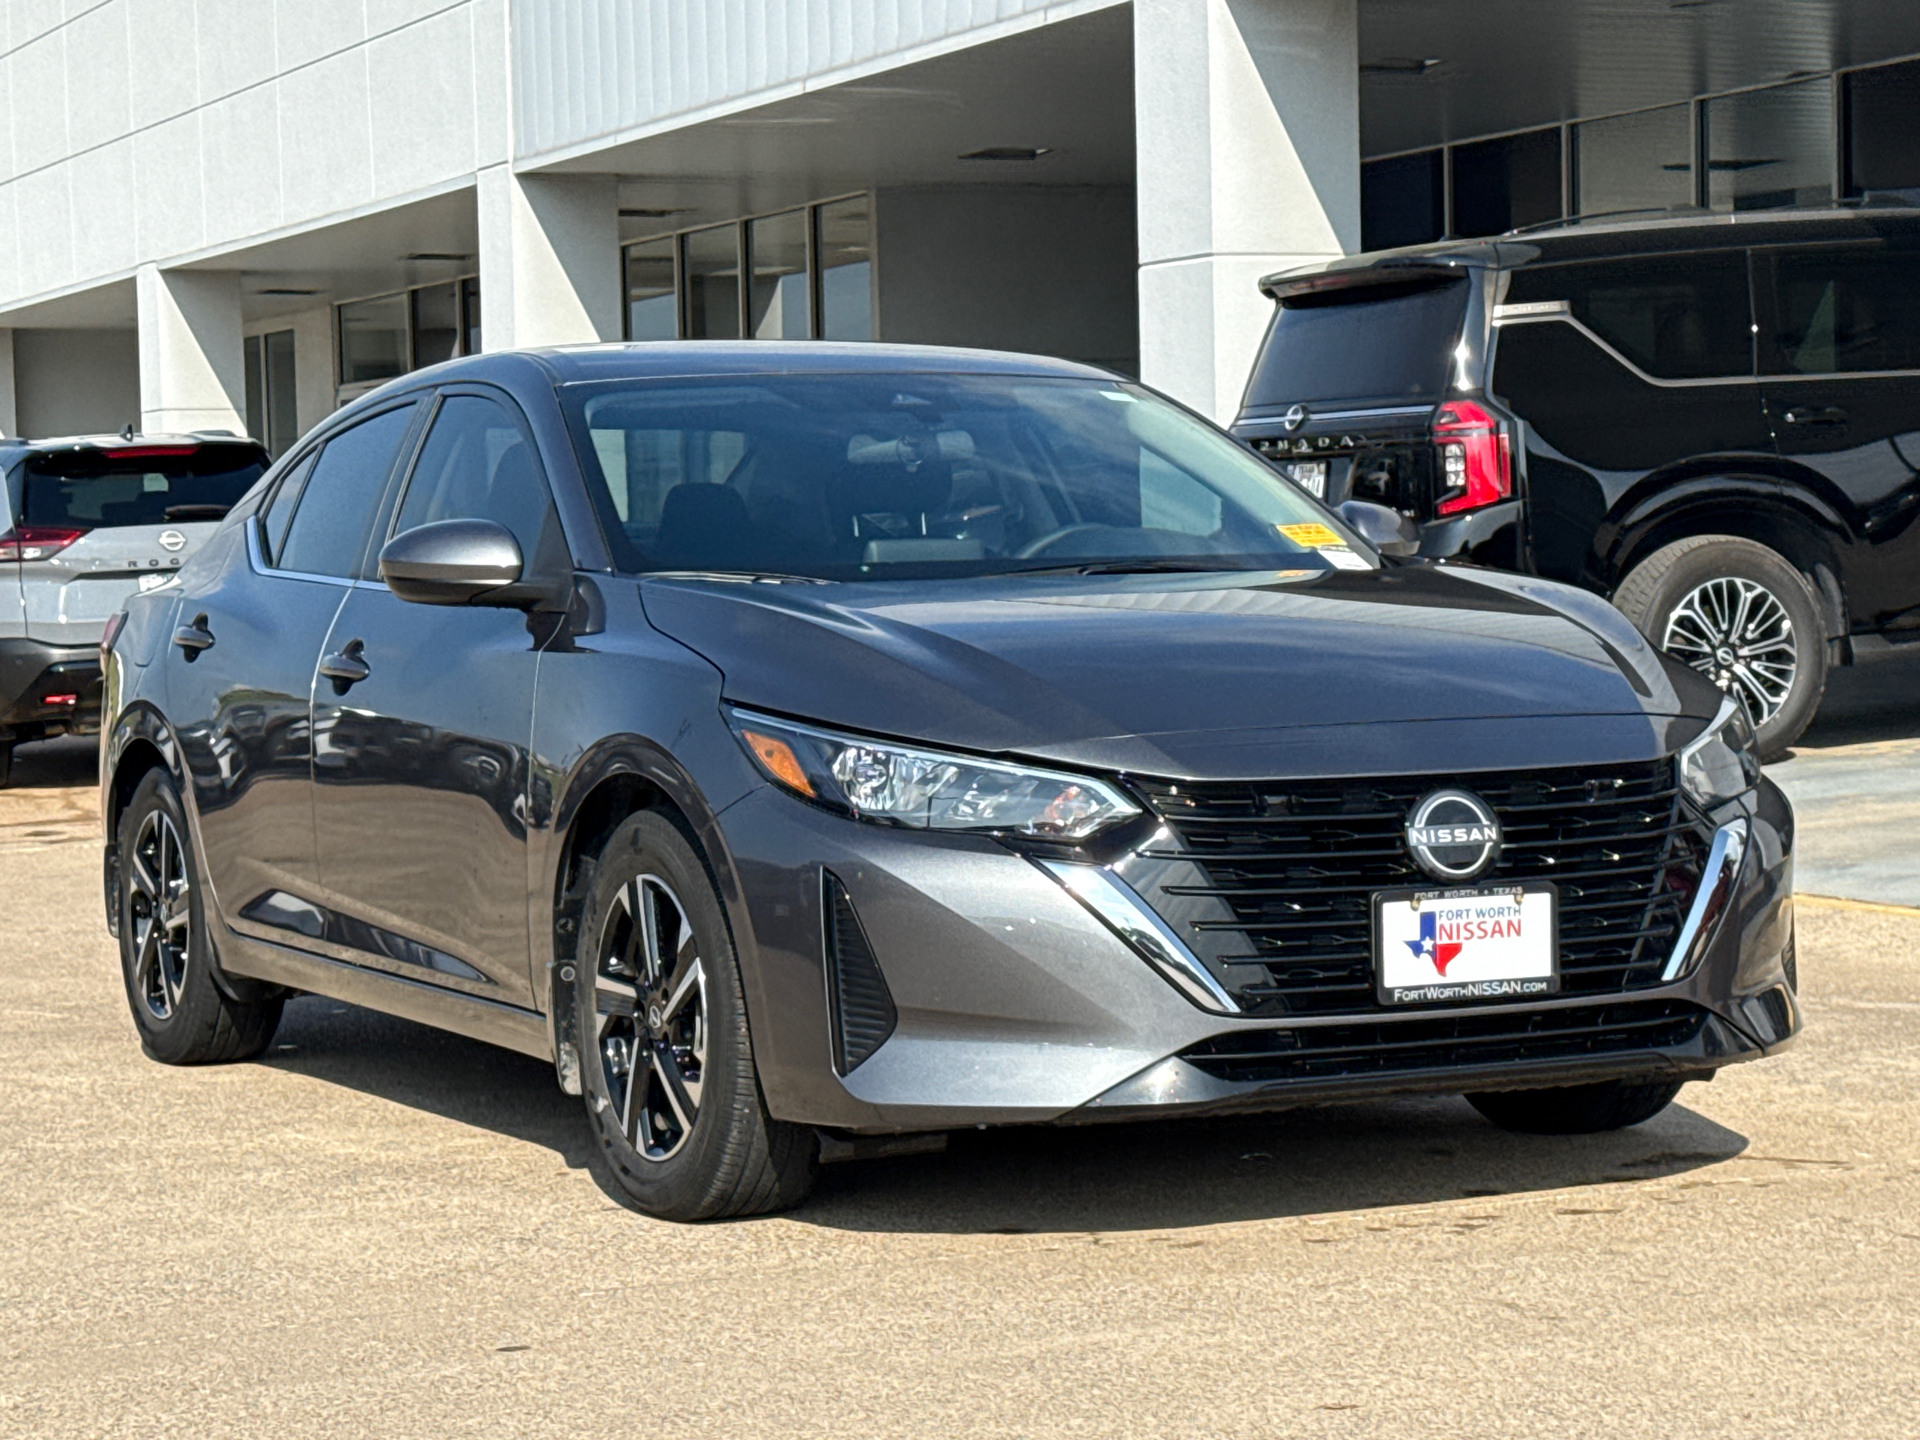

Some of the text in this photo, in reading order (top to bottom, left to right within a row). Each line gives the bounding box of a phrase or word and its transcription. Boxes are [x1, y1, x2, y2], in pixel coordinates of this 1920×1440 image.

[128, 557, 180, 568] ROG
[1412, 826, 1497, 844] NISSAN
[1414, 886, 1523, 900] FORT WORTH TEXAS
[1439, 906, 1522, 921] FORT WORTH
[1439, 919, 1522, 941] NISSAN
